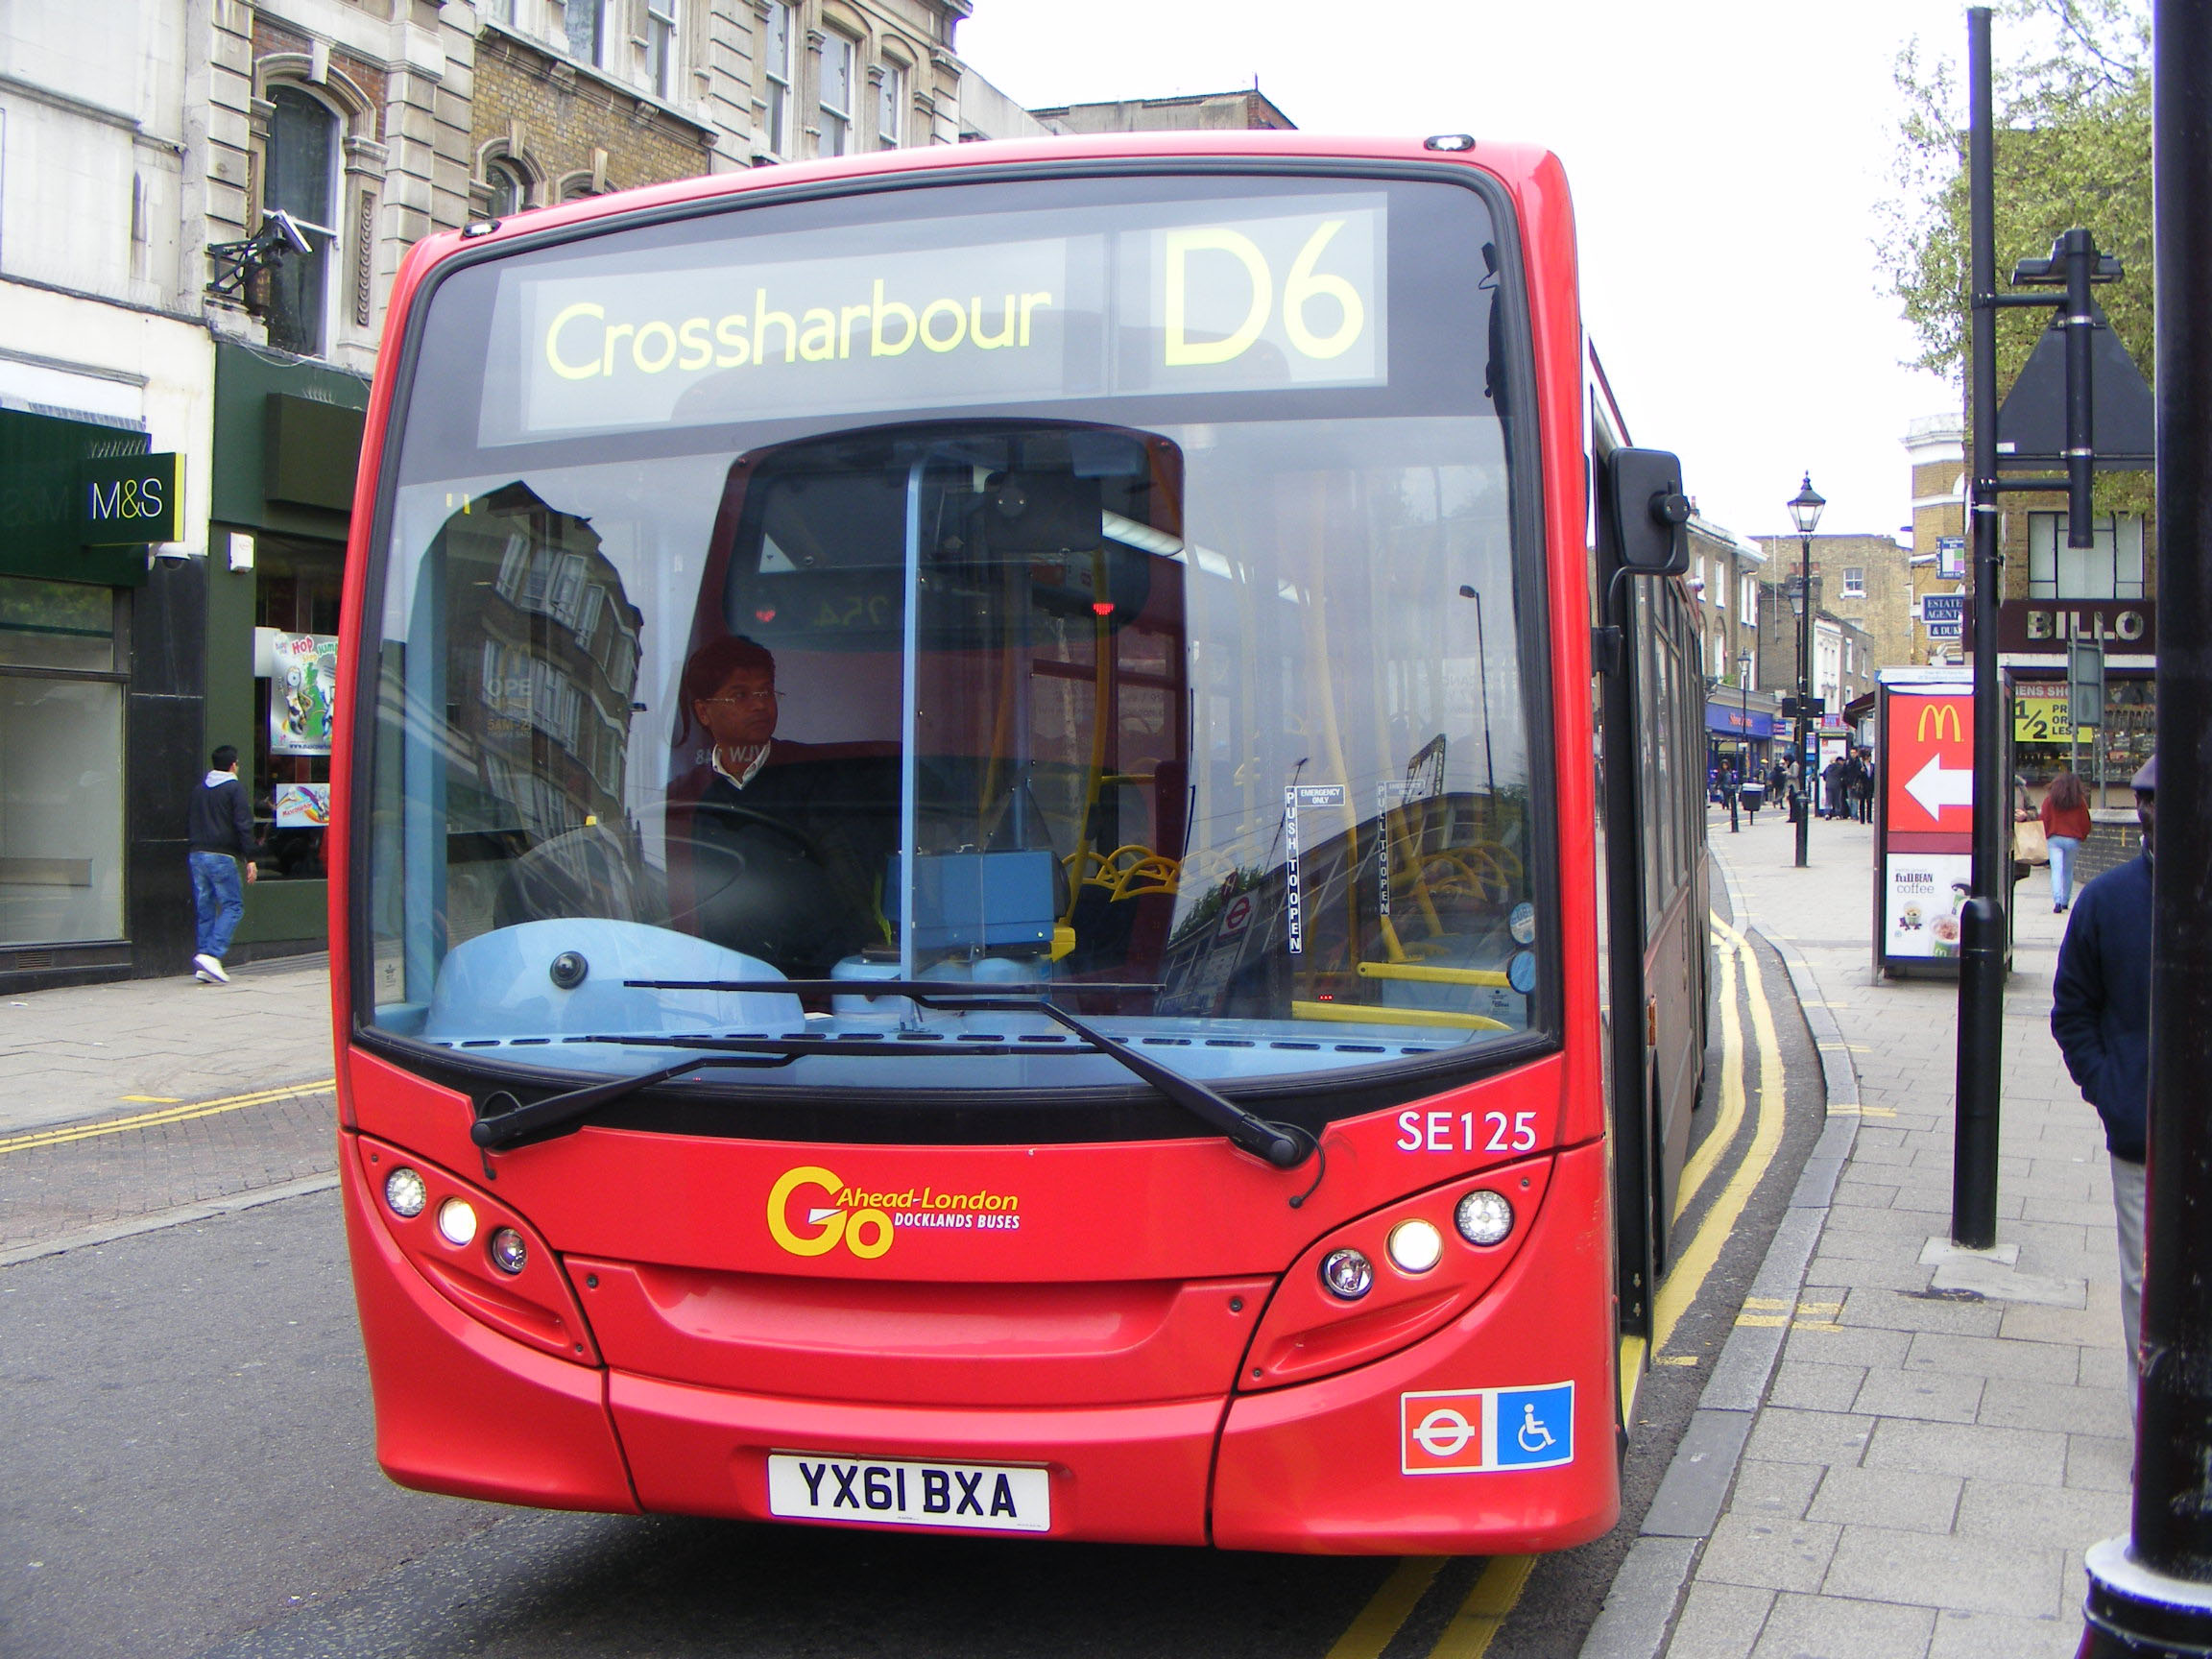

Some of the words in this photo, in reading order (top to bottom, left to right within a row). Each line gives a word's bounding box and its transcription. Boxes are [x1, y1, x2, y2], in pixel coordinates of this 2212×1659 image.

[1165, 219, 1364, 367] D6
[546, 279, 1052, 380] Crossharbour
[92, 478, 162, 519] M&S
[1927, 599, 1962, 609] ESTATE
[1932, 626, 1939, 636] &
[2027, 611, 2144, 640] BILLO
[292, 636, 314, 655] HOP
[2052, 727, 2080, 735] LES
[1301, 788, 1340, 797] EMERGENCY
[1311, 796, 1330, 805] ONLY
[1286, 792, 1296, 850] PUSH
[1380, 840, 1387, 862] TO
[1288, 859, 1297, 886] TO
[1381, 867, 1389, 915] OPEN
[1896, 883, 1935, 894] coffee
[1289, 892, 1300, 951] OPEN
[1397, 1111, 1537, 1151] SE125
[767, 1166, 894, 1260] Go
[836, 1187, 1019, 1211] Ahead-London
[894, 1212, 973, 1228] DOCKLANDS
[976, 1214, 1020, 1230] BUSES
[799, 1462, 906, 1512] YX61
[922, 1469, 1018, 1518] BXA
